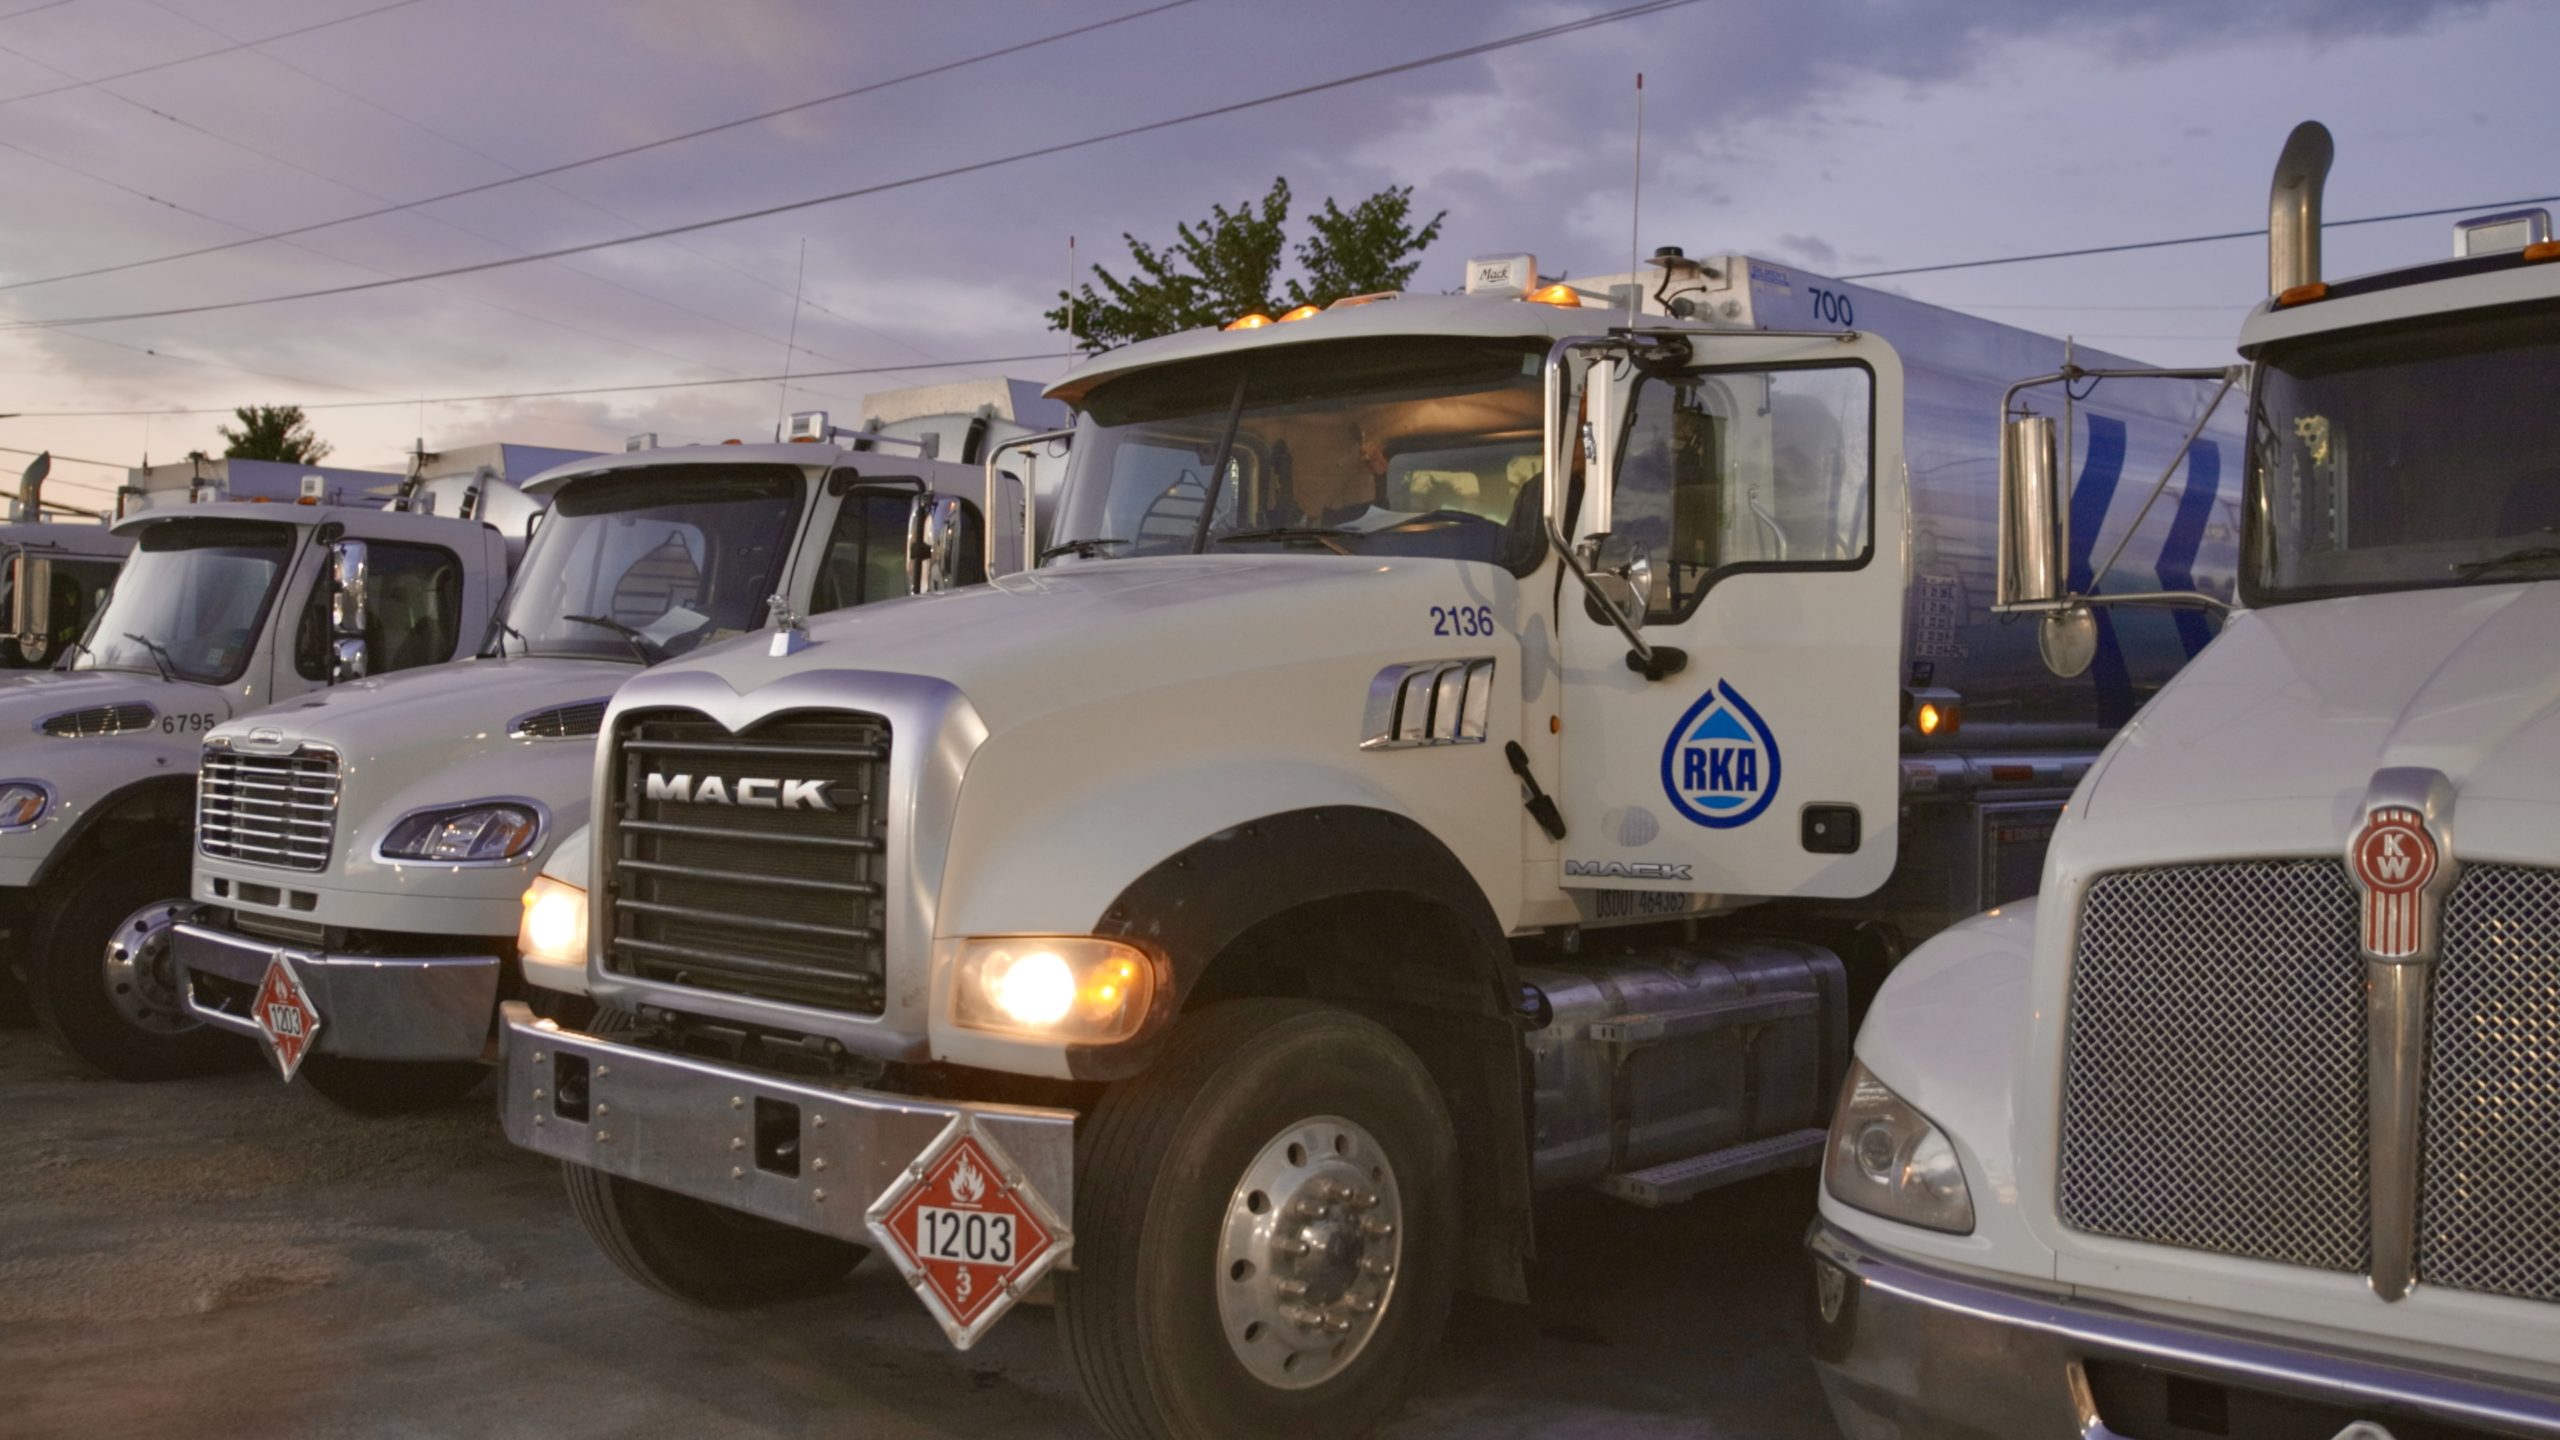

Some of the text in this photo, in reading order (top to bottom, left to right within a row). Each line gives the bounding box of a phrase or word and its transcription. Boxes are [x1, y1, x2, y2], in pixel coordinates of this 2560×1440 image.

[1808, 287, 1853, 327] 700
[1430, 606, 1494, 637] 2136
[162, 713, 215, 734] 6795
[1684, 747, 1757, 792] RKA
[646, 772, 837, 812] MACK
[1565, 859, 1693, 881] MACK
[271, 1005, 301, 1036] 1203
[924, 1209, 1012, 1263] 1203
[955, 1271, 973, 1298] 3
